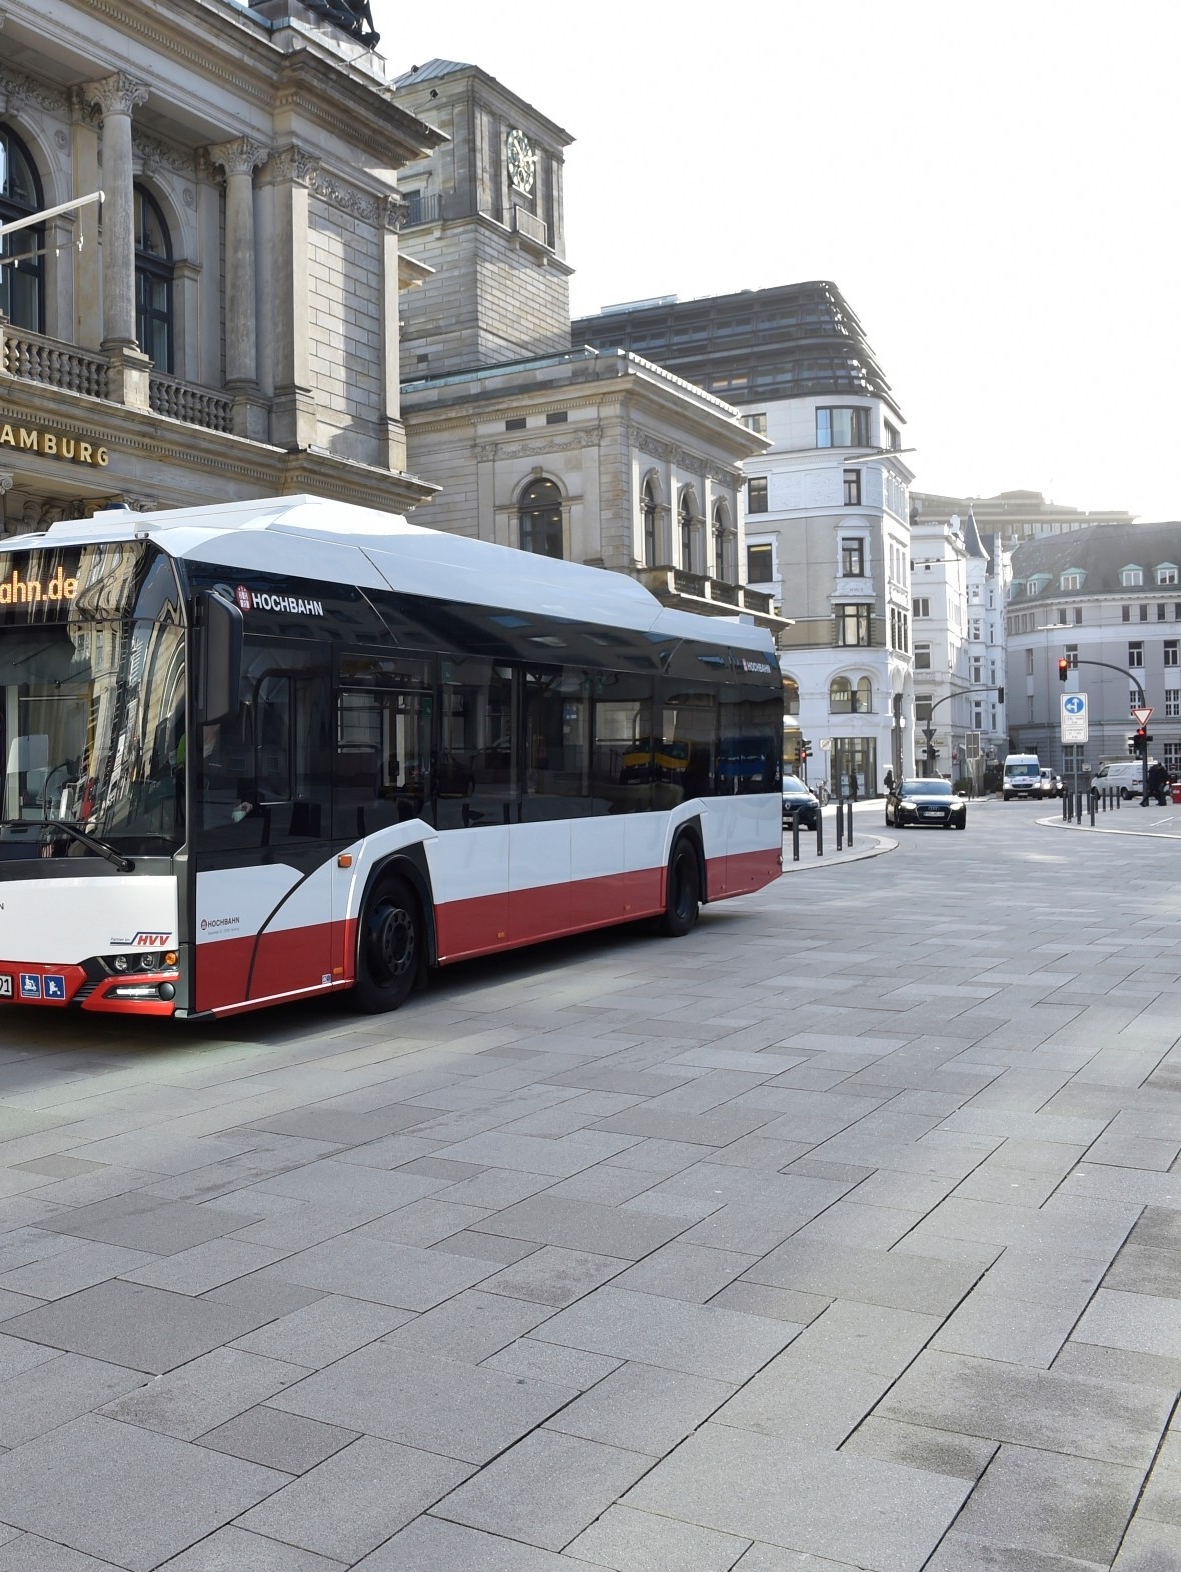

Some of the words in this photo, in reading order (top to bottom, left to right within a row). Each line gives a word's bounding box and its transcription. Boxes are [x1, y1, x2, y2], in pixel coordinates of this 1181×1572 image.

[251, 592, 324, 616] HOCHBAHN
[747, 661, 771, 673] HOCHBAHN
[207, 916, 240, 928] HOCHBAHN
[137, 935, 170, 946] HVV
